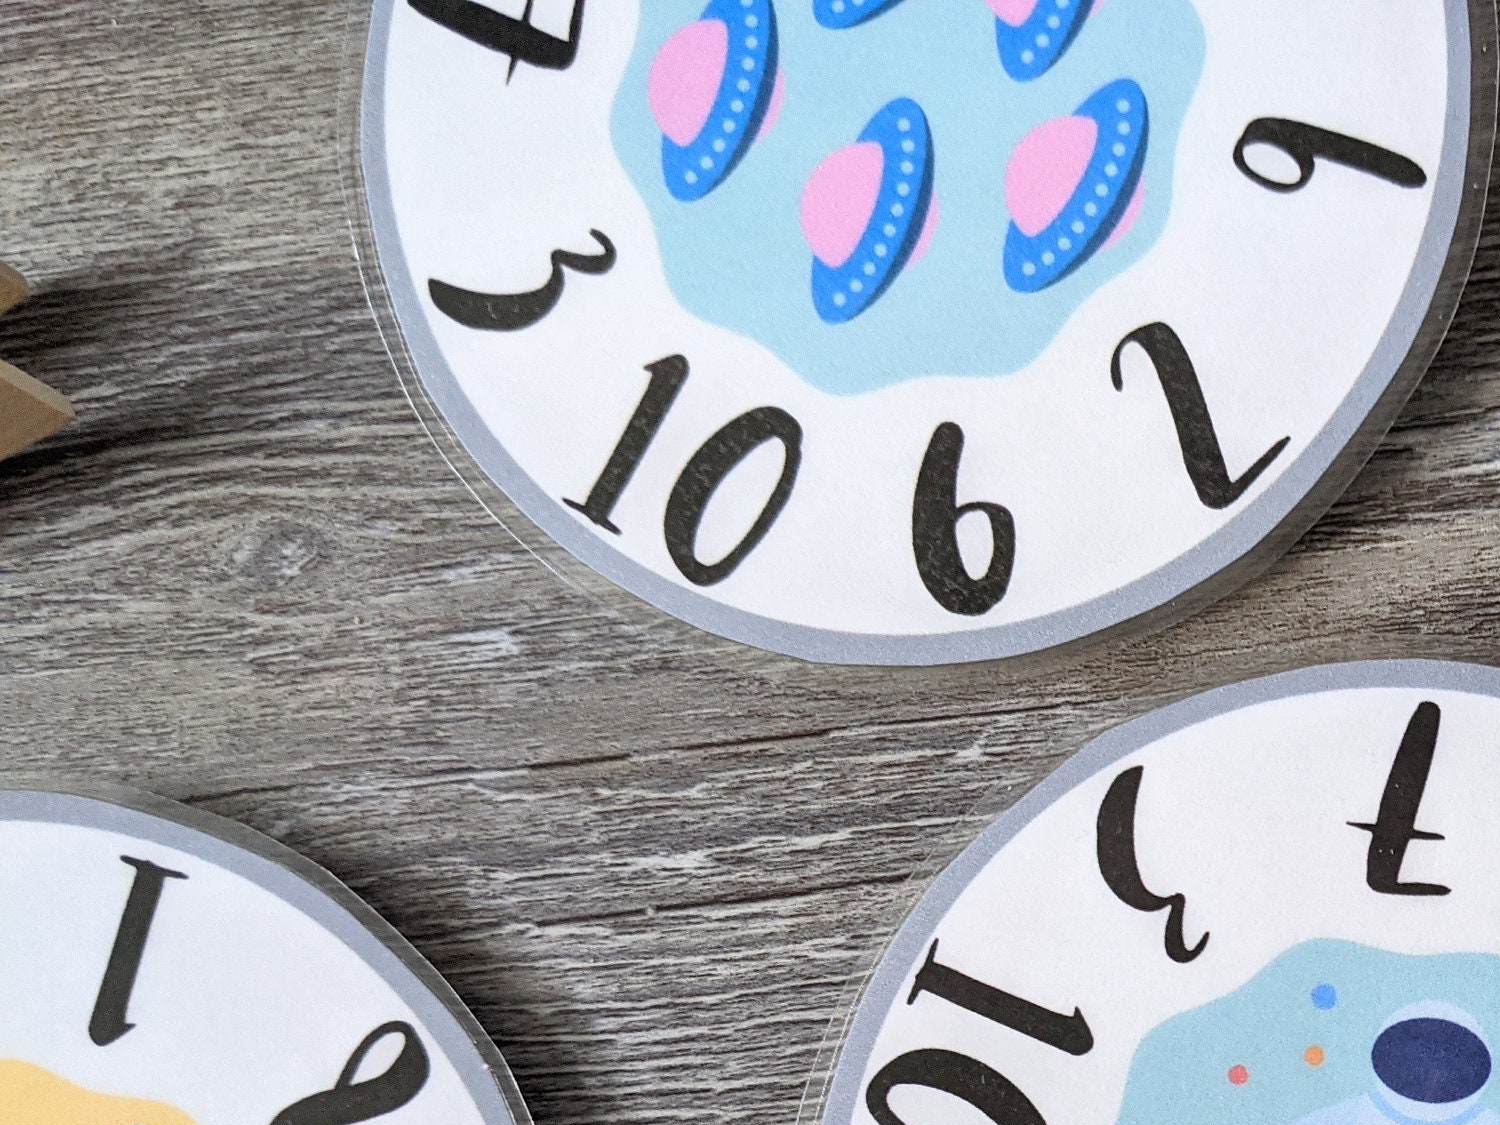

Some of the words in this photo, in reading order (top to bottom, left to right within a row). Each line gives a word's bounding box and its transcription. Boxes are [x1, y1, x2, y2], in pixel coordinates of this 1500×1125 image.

[406, 0, 585, 83] 7
[1232, 117, 1427, 193] 9
[428, 228, 616, 331] 3
[562, 354, 802, 586] 10
[1110, 321, 1291, 510] 2
[912, 421, 1015, 616] 6
[1096, 765, 1210, 970] 3
[1346, 701, 1452, 896] 7
[88, 855, 188, 1046] 1
